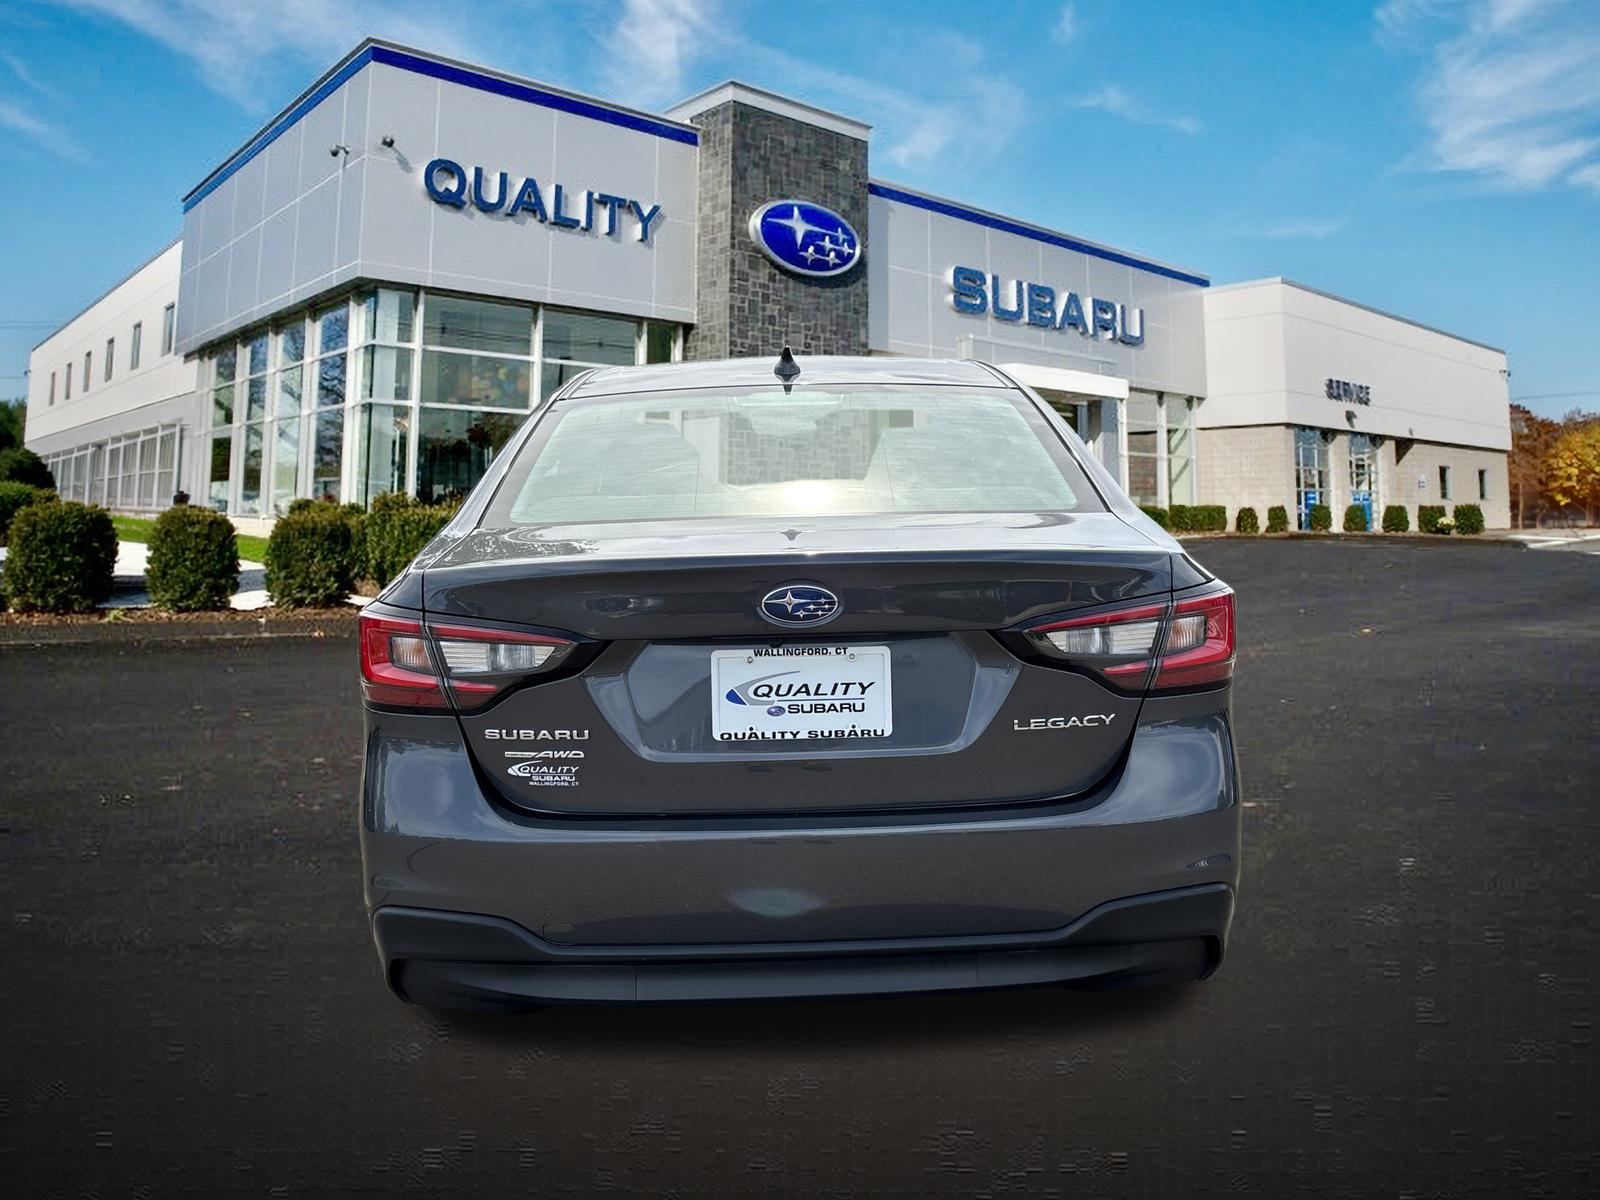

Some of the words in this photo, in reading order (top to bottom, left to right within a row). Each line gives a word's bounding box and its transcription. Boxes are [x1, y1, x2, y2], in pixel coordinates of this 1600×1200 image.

[424, 158, 661, 243] QUALITY
[951, 265, 1144, 346] SUBARU
[1326, 378, 1371, 406] SERVICE
[835, 647, 848, 655] CT
[753, 682, 875, 698] QUALITY
[787, 702, 865, 714] SUBARU
[1013, 713, 1116, 731] LEGACY
[484, 729, 589, 740] SUBARU
[719, 731, 801, 741] QUALITY
[807, 729, 885, 739] SUBARU
[534, 750, 585, 759] AWD
[519, 766, 580, 774] QUALITY
